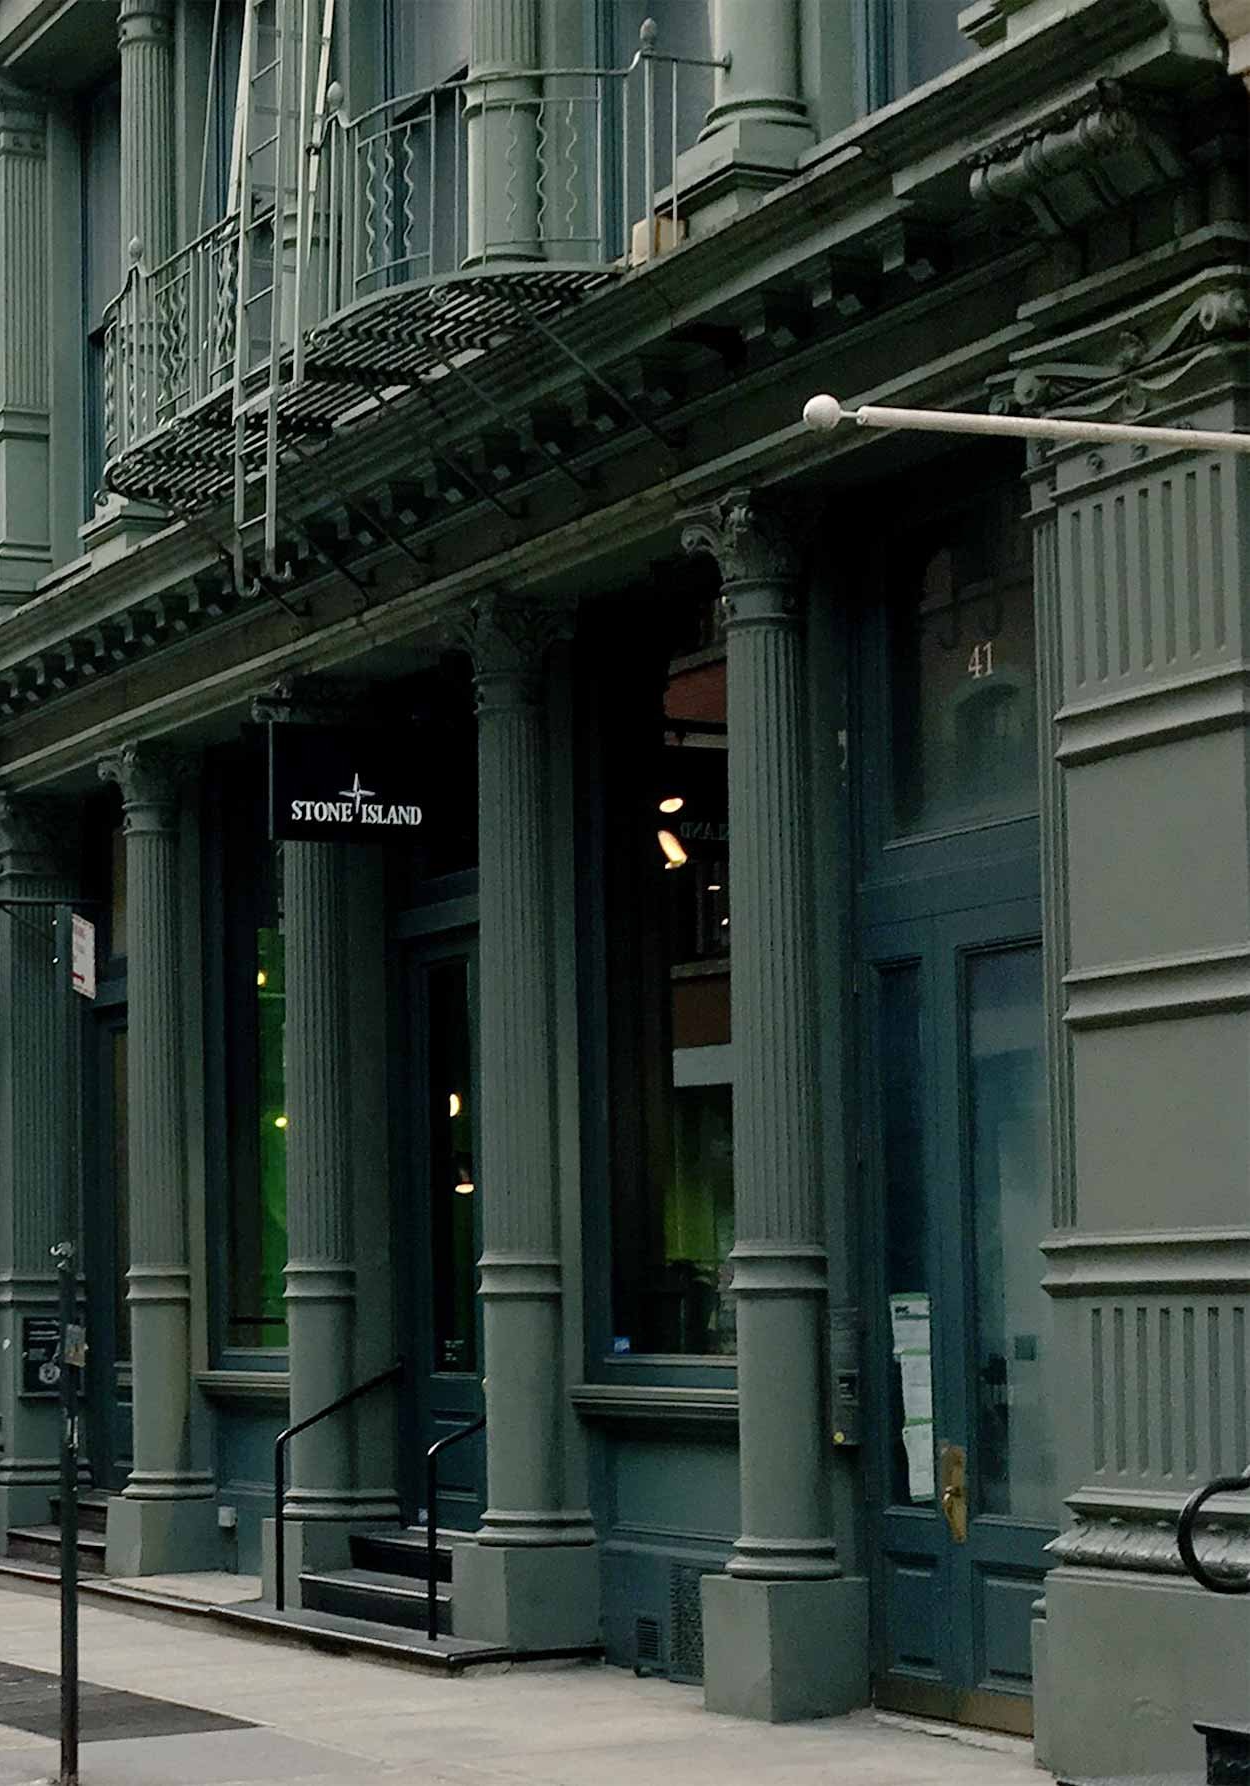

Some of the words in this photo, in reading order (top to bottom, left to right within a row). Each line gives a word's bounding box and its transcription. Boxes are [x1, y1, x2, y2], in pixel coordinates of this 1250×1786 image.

[967, 641, 994, 680] 41
[291, 800, 353, 823] STONE
[360, 803, 423, 826] ISLAND
